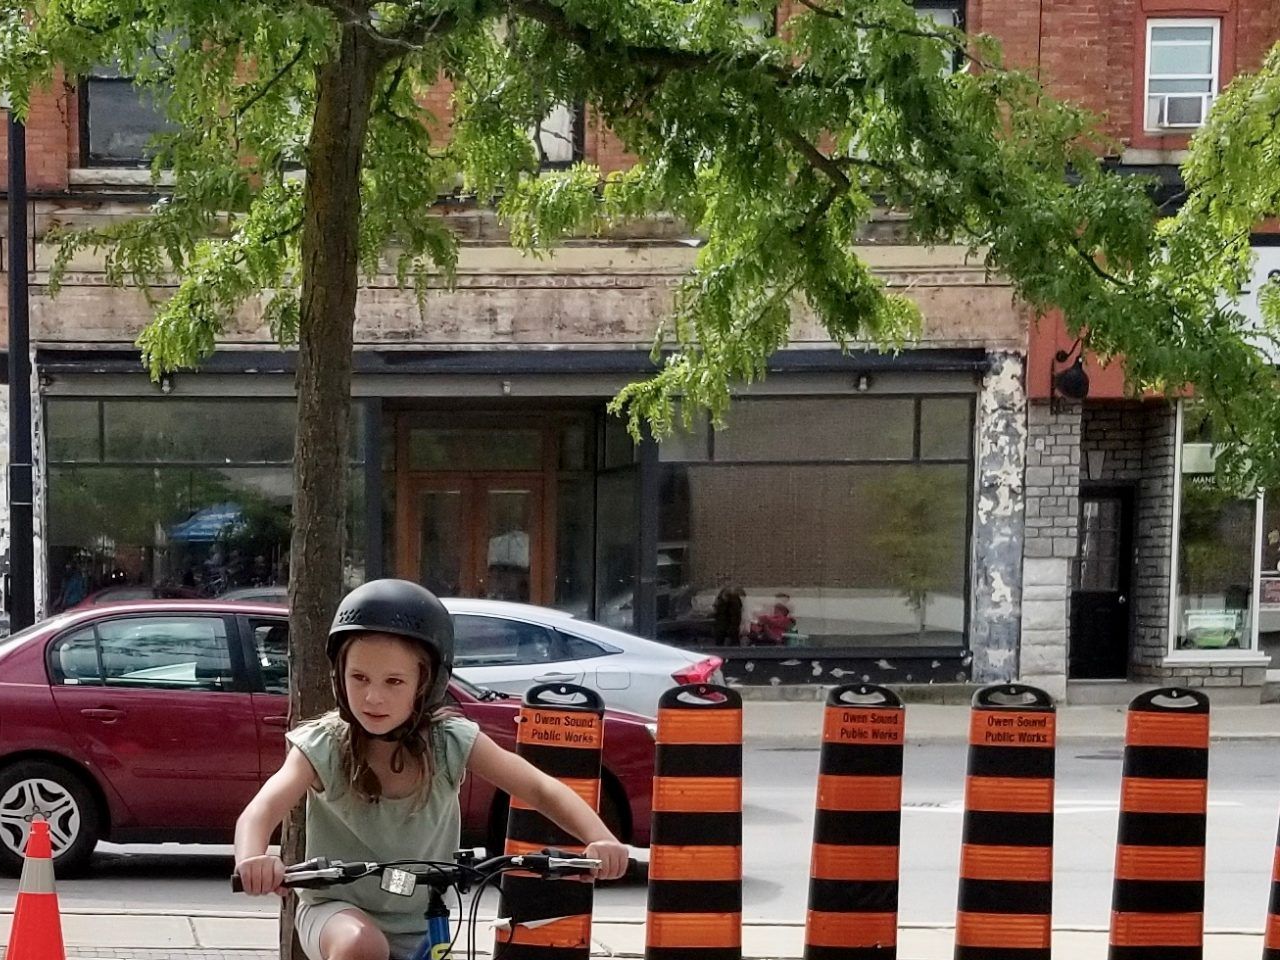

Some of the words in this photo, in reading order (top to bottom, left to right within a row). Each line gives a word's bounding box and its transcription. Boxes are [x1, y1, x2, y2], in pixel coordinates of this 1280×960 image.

[534, 713, 560, 725] Owen
[564, 715, 594, 728] Sound
[843, 712, 867, 723] Owen
[870, 713, 898, 724] Sound
[987, 715, 1014, 727] Owen
[1017, 716, 1047, 727] Sound
[532, 729, 560, 741] Public
[564, 731, 594, 743] Works
[841, 728, 869, 739] Public
[872, 729, 898, 740] Works
[985, 731, 1015, 742] Public
[1018, 732, 1047, 743] Works
